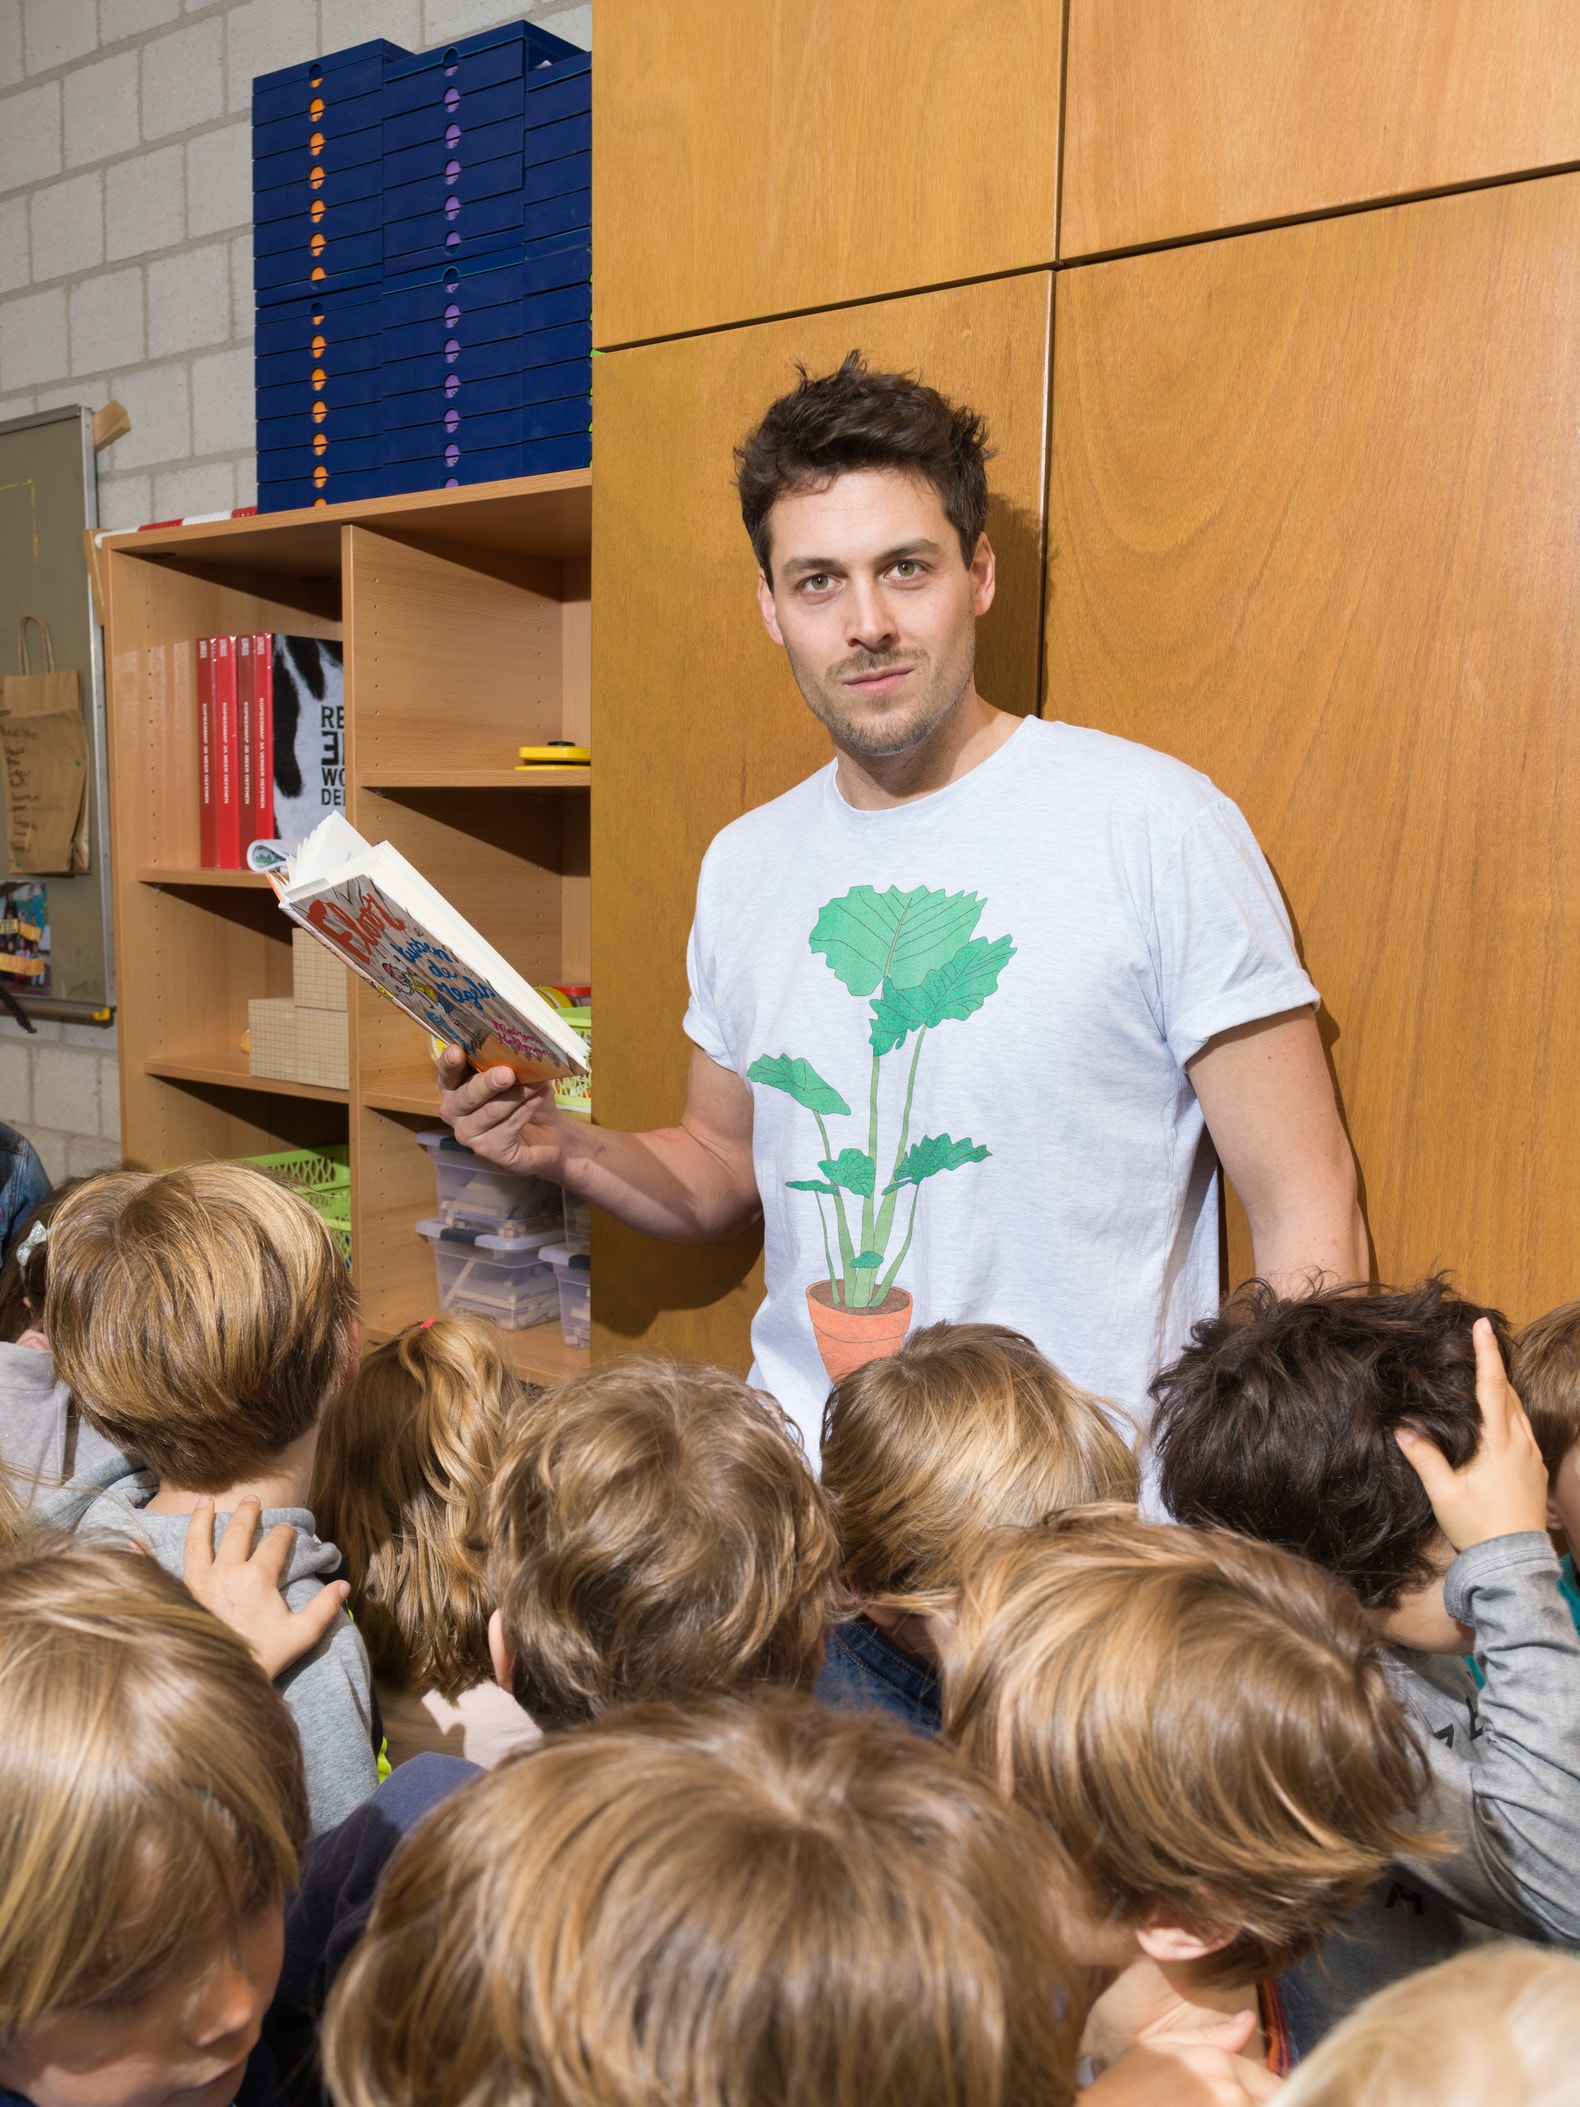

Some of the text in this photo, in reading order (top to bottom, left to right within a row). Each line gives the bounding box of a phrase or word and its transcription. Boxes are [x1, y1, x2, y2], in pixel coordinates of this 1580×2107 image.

[306, 893, 406, 965] Floor
[390, 938, 453, 964] tussen
[428, 960, 458, 979] de
